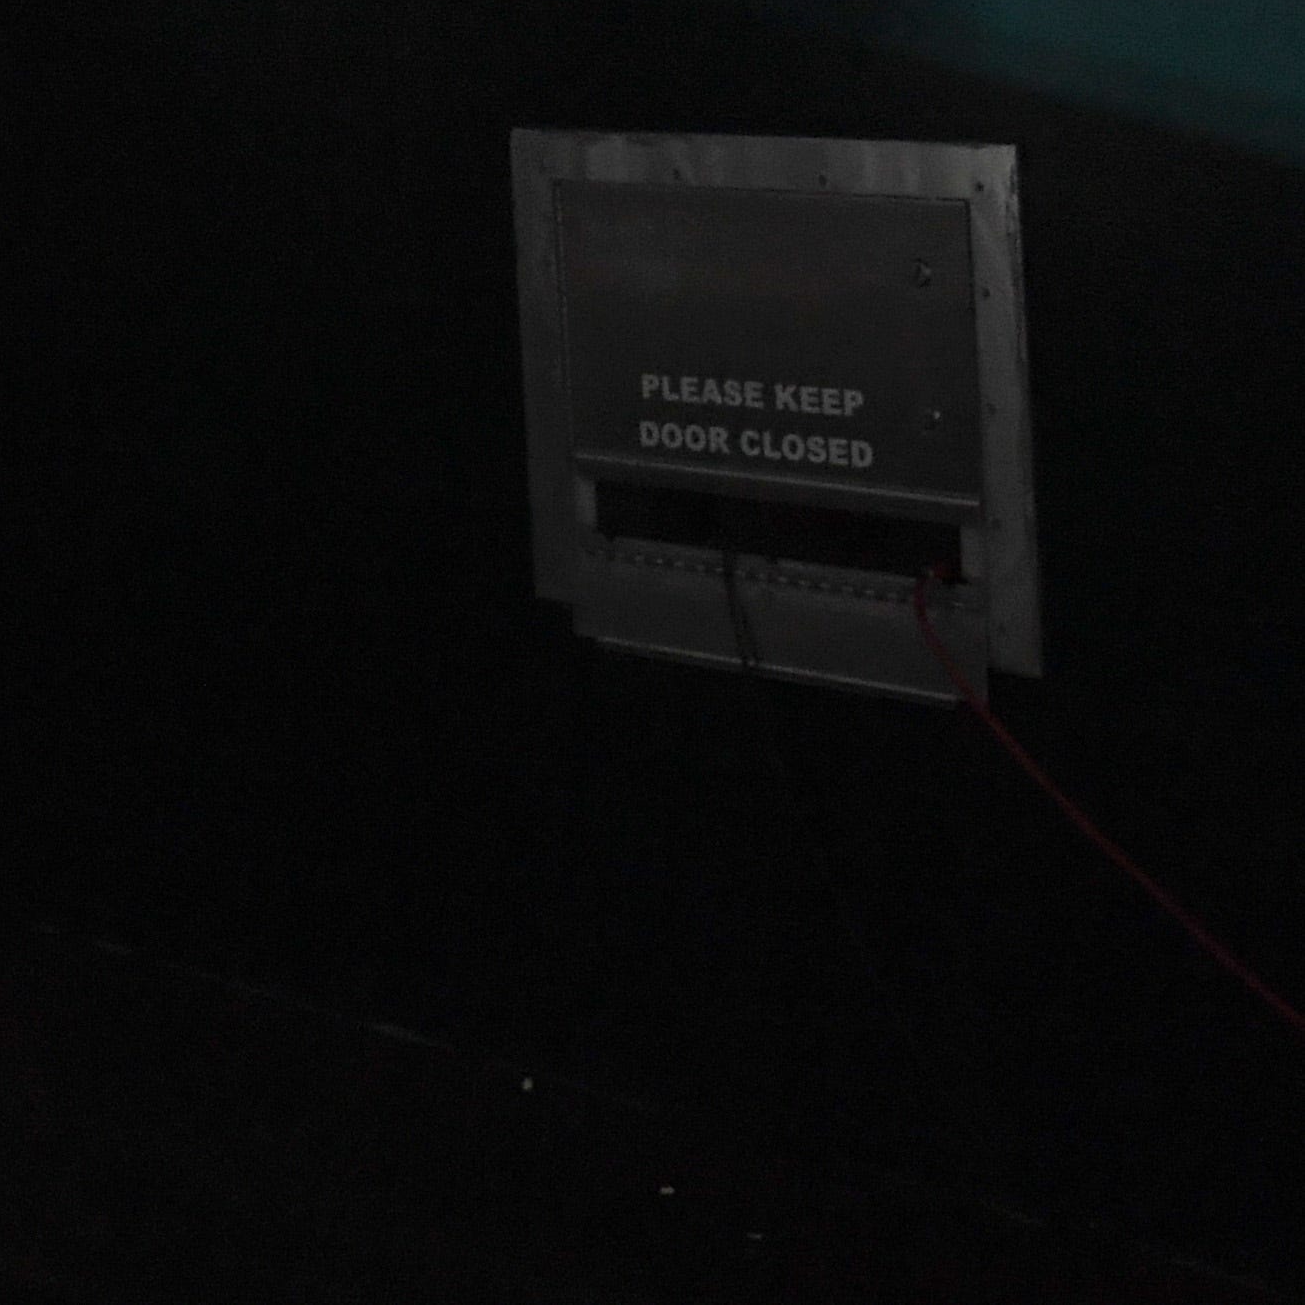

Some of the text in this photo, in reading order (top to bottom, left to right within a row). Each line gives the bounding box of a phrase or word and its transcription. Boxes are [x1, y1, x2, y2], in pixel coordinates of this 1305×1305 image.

[641, 373, 865, 417] PLEASE KEEP
[639, 420, 873, 468] DOOR CLOSED
